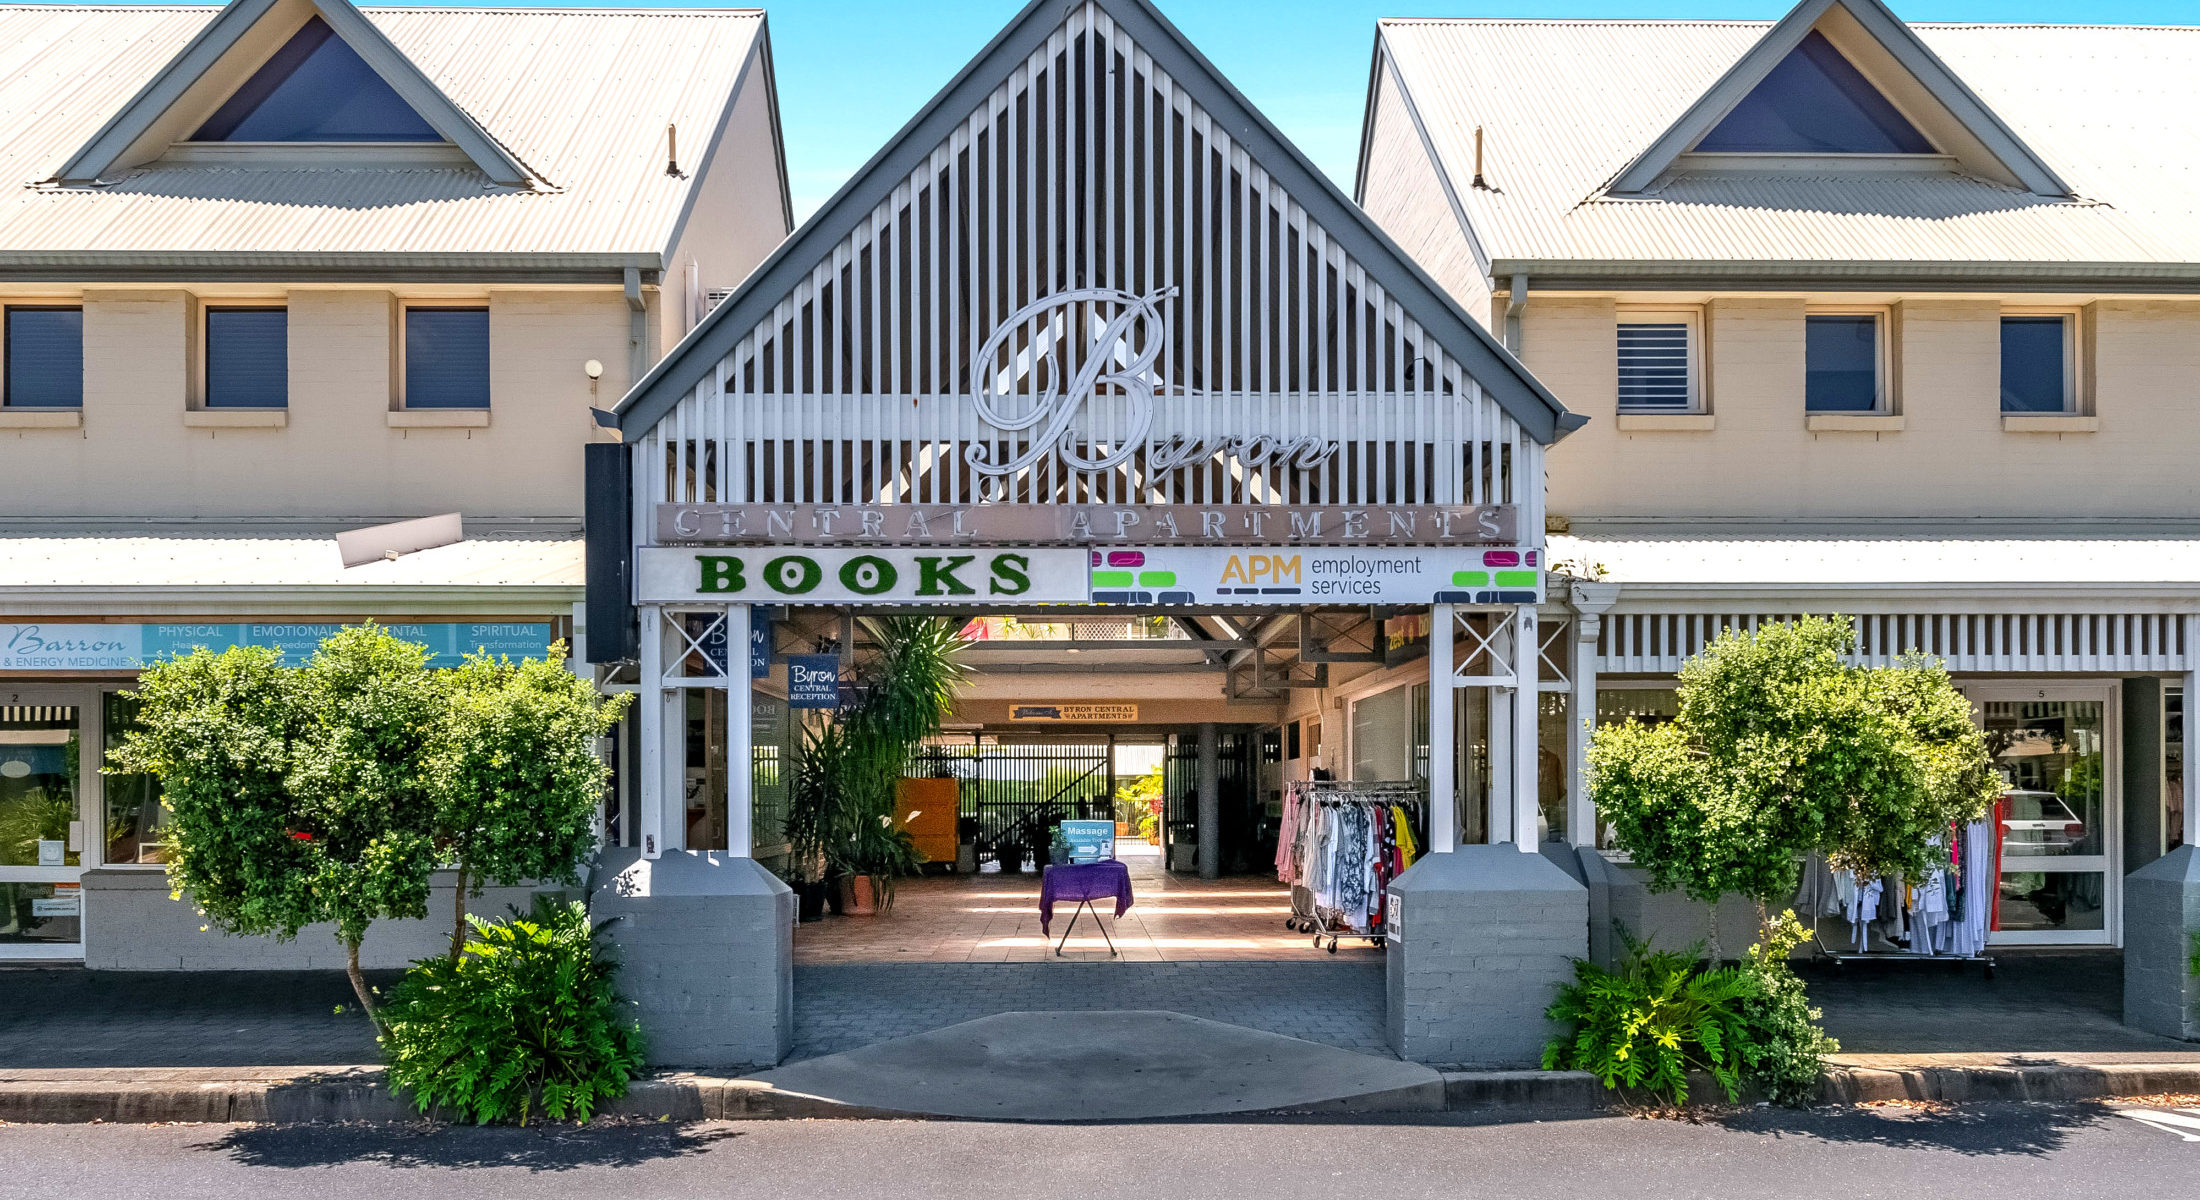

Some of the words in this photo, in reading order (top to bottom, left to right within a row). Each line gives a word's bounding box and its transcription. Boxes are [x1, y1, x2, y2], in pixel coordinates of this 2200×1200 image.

[964, 285, 1340, 491] Byron
[672, 508, 979, 539] CENTRAL
[1069, 509, 1502, 539] APARTMENTS
[694, 552, 1032, 596] BOOKS
[1218, 554, 1302, 585] APM
[1311, 555, 1422, 578] employment
[1311, 575, 1382, 595] services
[158, 625, 223, 637] PHYSICAL
[252, 625, 334, 637] EMOTIONAL
[471, 625, 538, 637] SPIRITUAL
[7, 625, 127, 655] Barron
[273, 640, 316, 649] Freedom
[4, 657, 12, 667] &
[16, 657, 65, 667] ENERGY
[68, 657, 127, 667] MEDICINE
[791, 665, 836, 687] Byron
[12, 694, 19, 702] 2
[2038, 690, 2045, 698] 5
[1070, 712, 1128, 720] APARTMENTS
[1068, 827, 1108, 836] Massage
